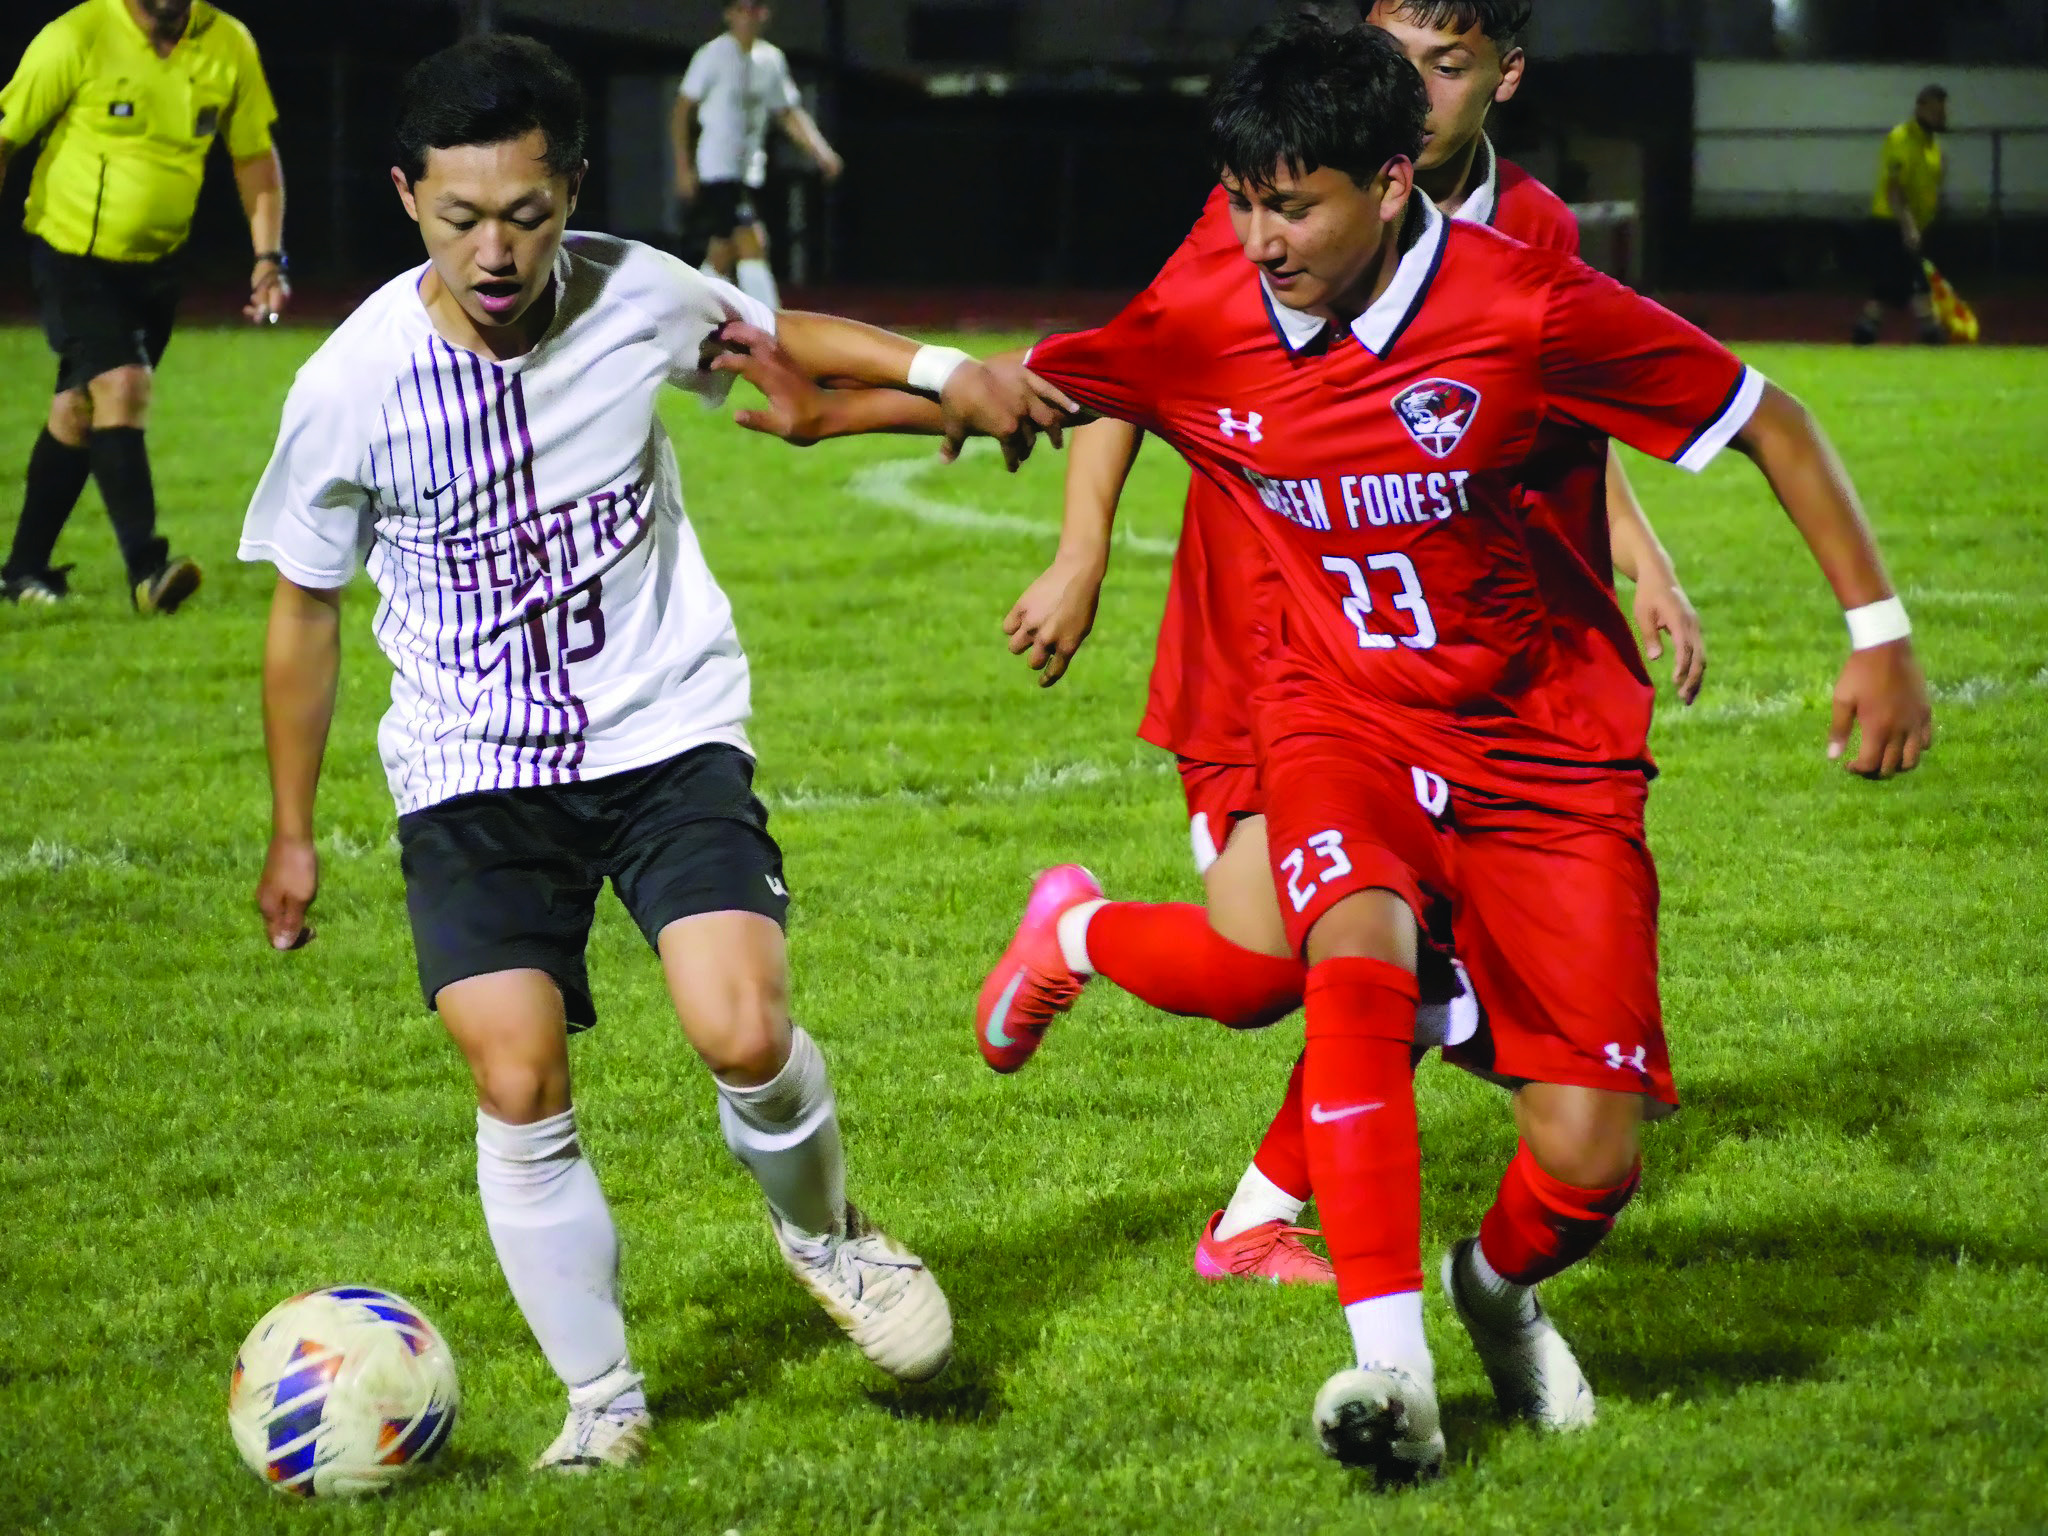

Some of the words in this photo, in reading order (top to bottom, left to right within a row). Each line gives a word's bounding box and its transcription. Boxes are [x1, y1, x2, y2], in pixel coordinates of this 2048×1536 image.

[1340, 471, 1469, 528] FOREST
[524, 575, 606, 674] 13
[1321, 552, 1437, 649] 23
[1280, 829, 1352, 912] 23
